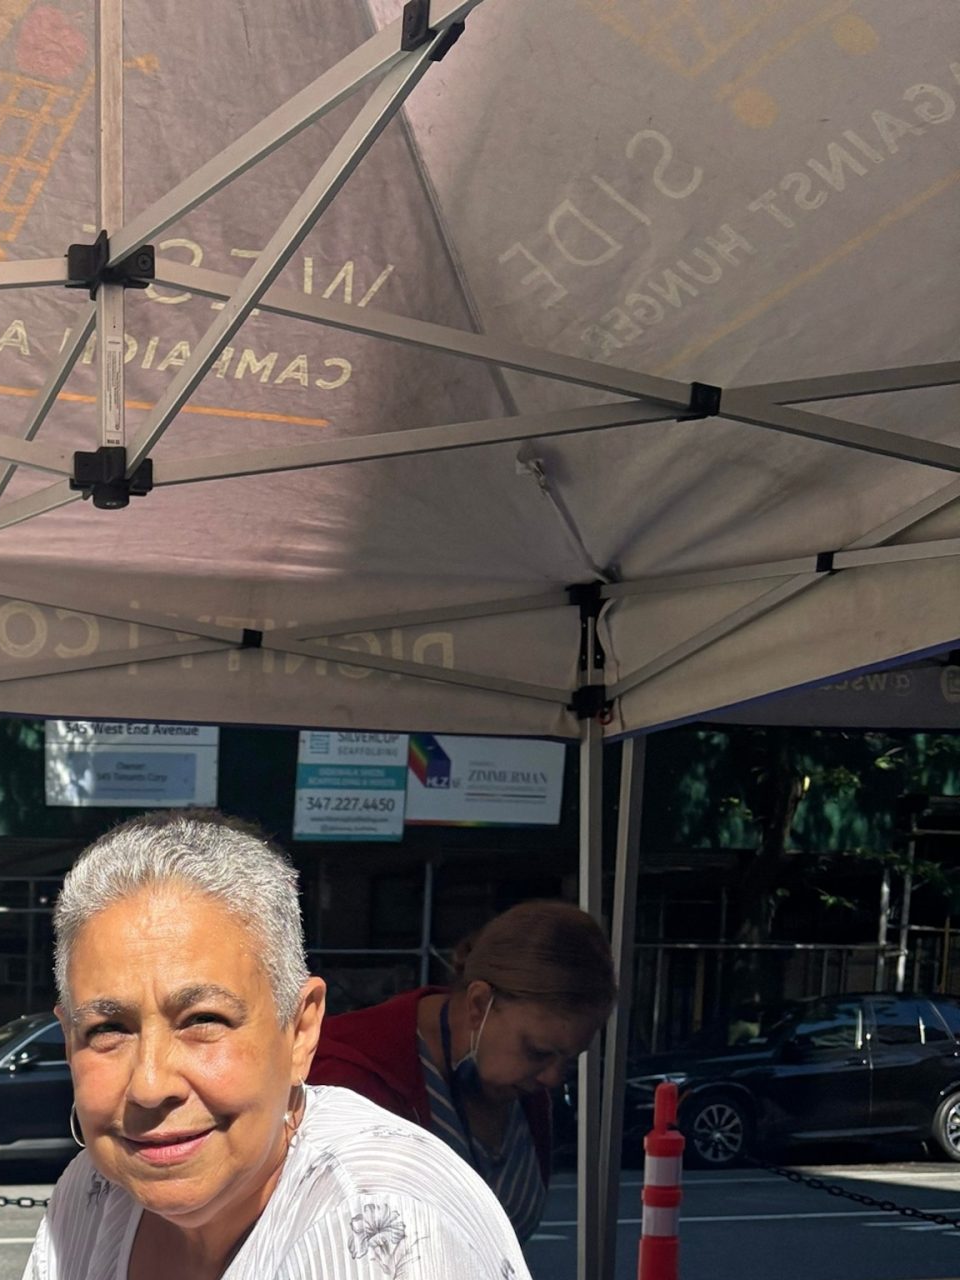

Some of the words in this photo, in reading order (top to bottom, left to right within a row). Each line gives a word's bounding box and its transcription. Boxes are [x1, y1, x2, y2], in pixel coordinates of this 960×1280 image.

[93, 722, 124, 735] West
[126, 723, 151, 736] End
[152, 724, 201, 737] Avenue
[305, 796, 397, 812] 347.227.4450
